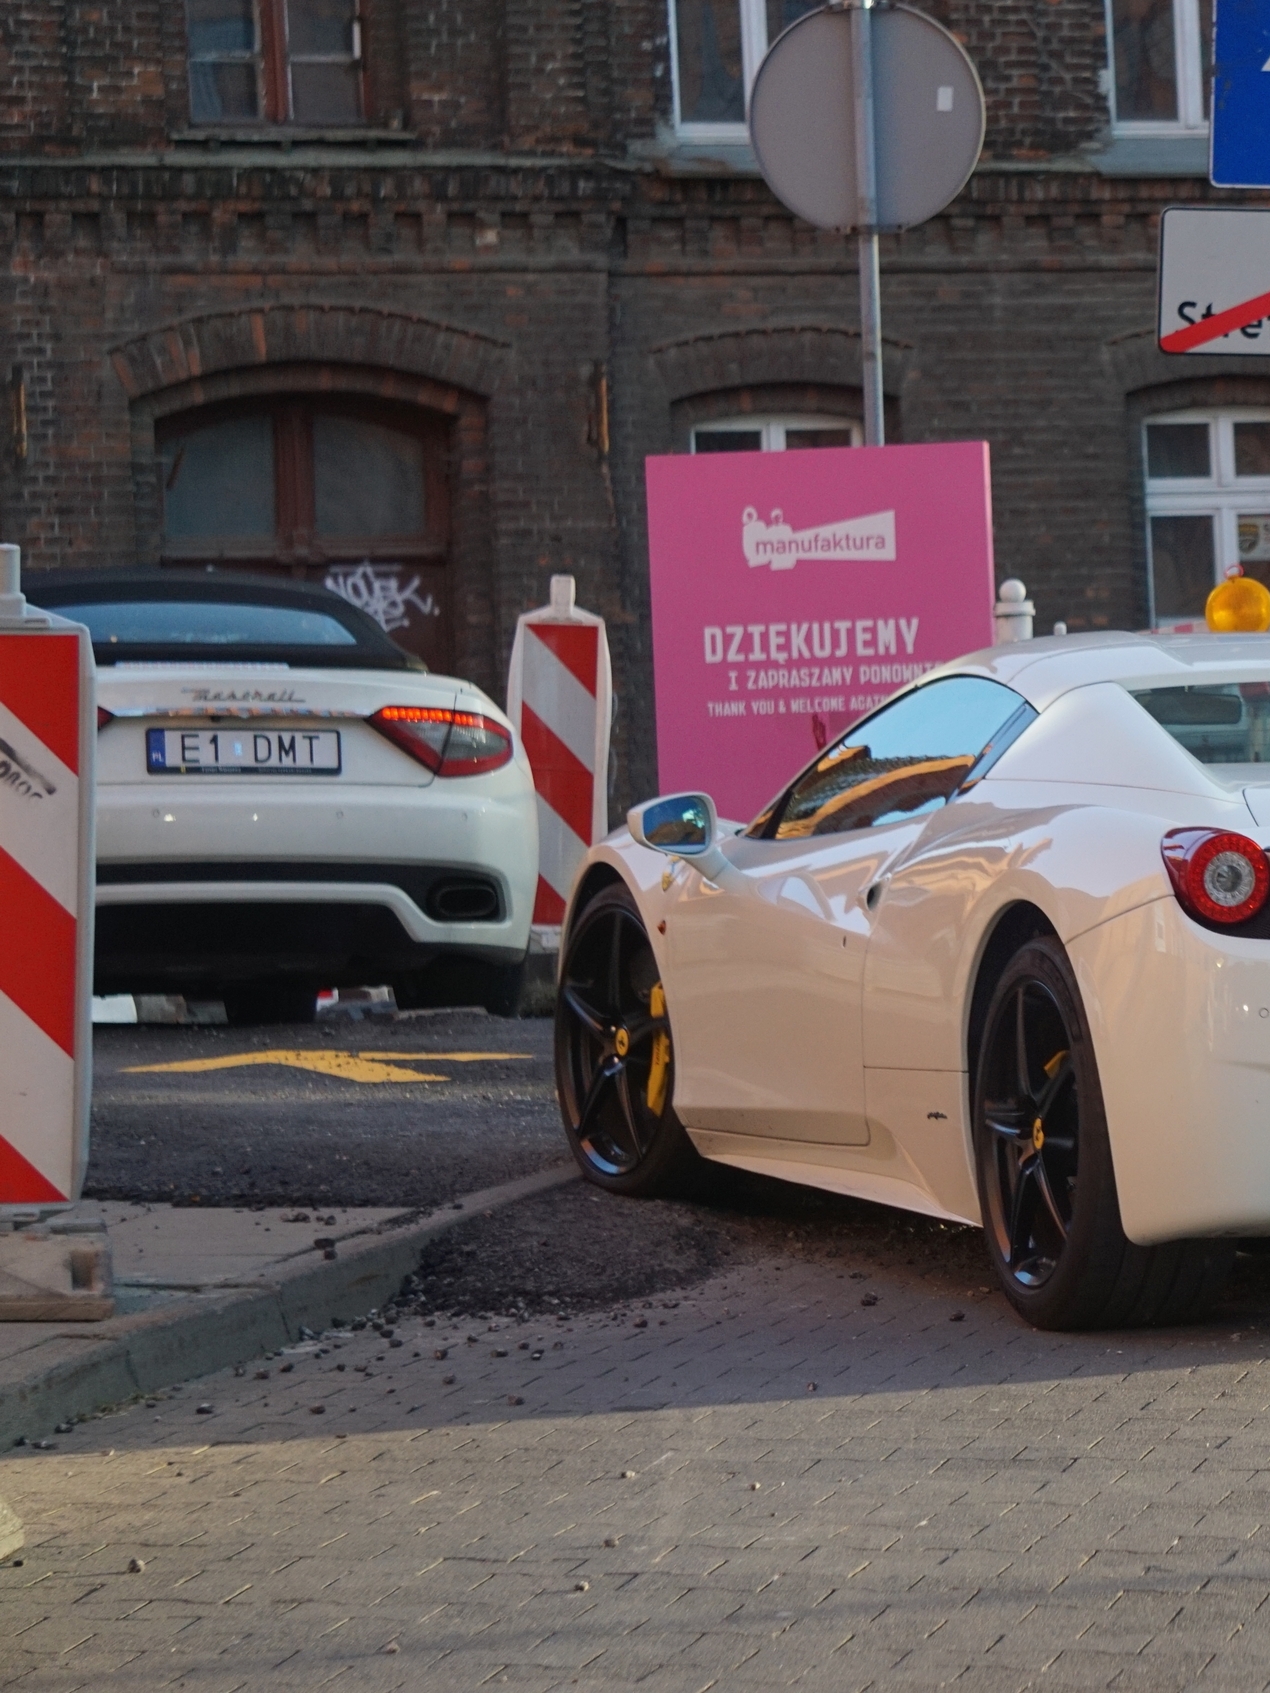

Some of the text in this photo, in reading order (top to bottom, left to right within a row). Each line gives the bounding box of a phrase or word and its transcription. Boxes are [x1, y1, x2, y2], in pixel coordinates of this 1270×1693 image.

[755, 533, 886, 556] manufaktura
[704, 617, 919, 665] DZIĘKUJEMY
[728, 670, 739, 691] I
[747, 666, 854, 690] ZAPRASZAMY
[708, 701, 746, 718] THANK
[751, 699, 775, 715] YOU
[778, 699, 787, 714] &
[790, 695, 846, 714] WELCOME
[181, 733, 320, 764] E1 DMT
